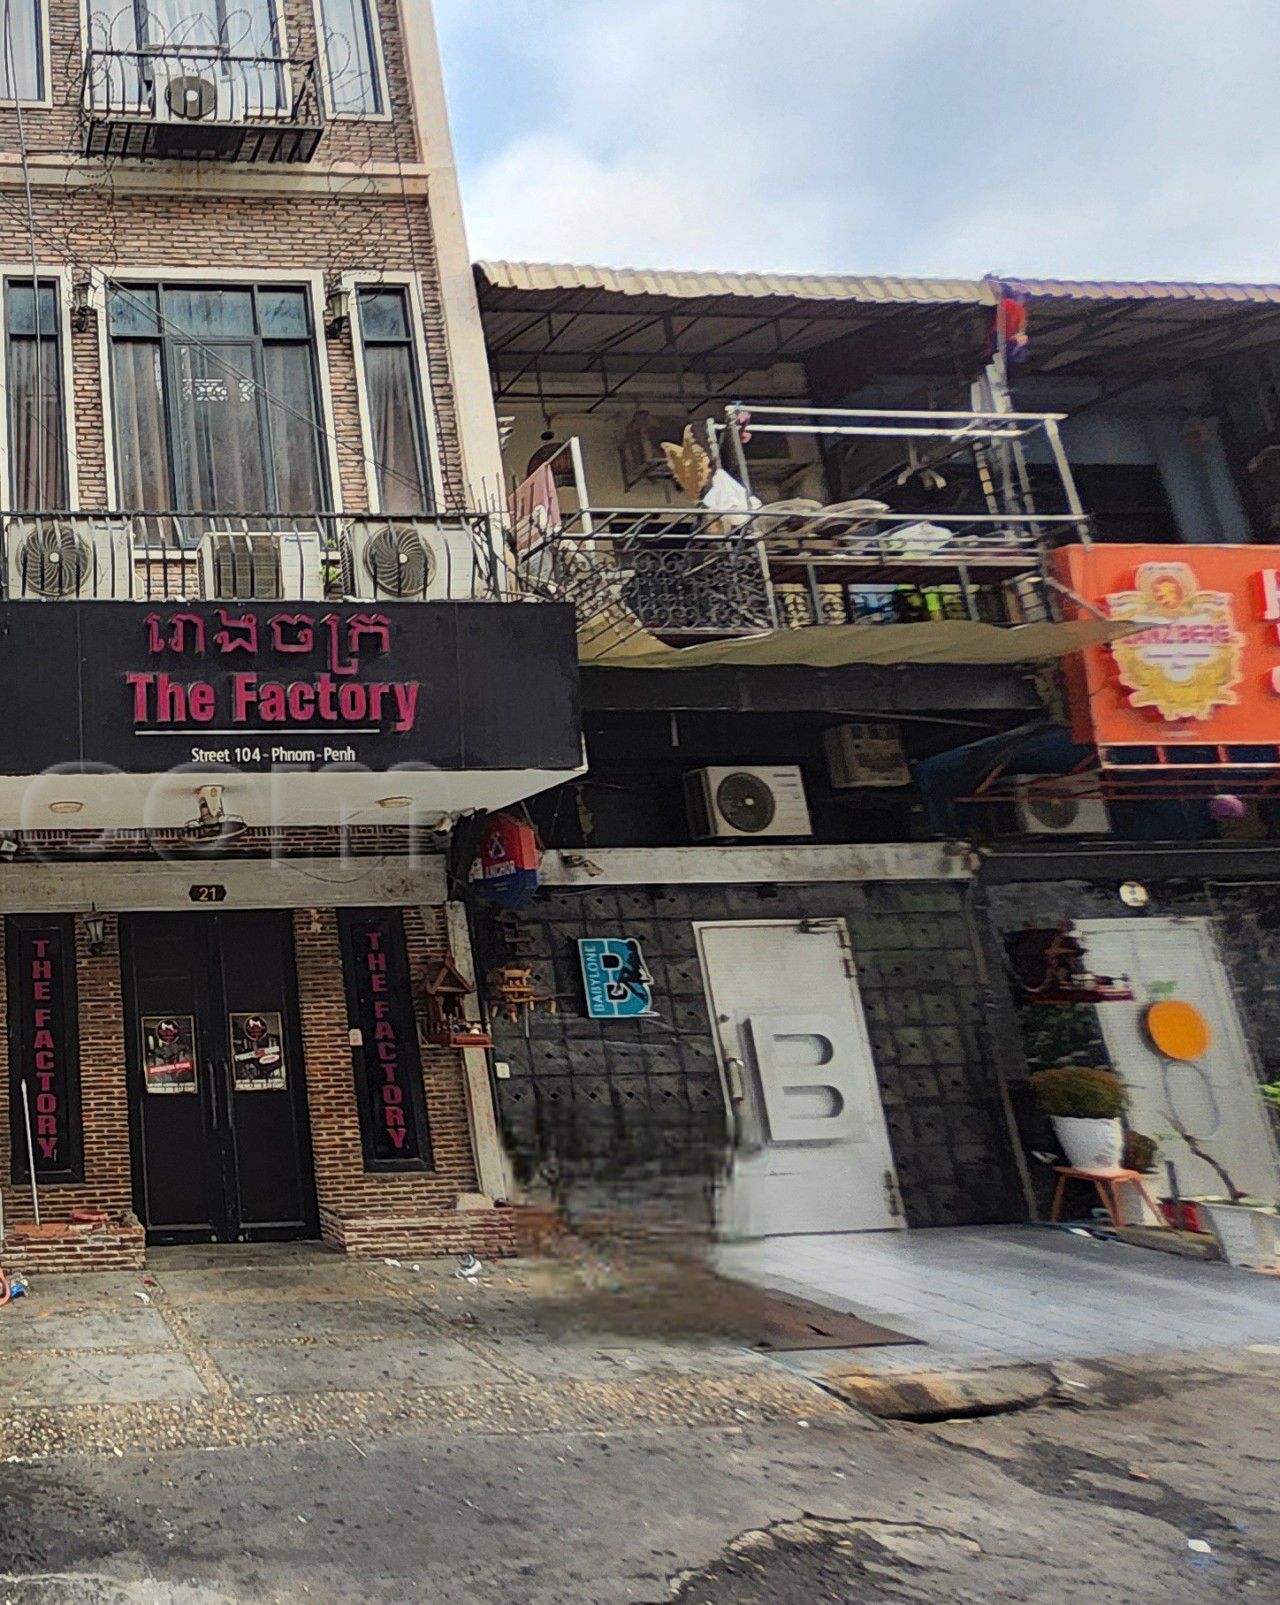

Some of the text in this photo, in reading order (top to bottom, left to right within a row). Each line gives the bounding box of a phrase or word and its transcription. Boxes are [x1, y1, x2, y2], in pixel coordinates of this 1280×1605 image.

[144, 608, 391, 675] រោងចក្រ
[126, 672, 419, 732] The Factory
[191, 747, 230, 762] Street
[199, 887, 215, 901] 21
[583, 944, 607, 1012] BABYLONE
[32, 940, 57, 1158] THE FACTORY
[366, 933, 407, 1149] THE FACTORY
